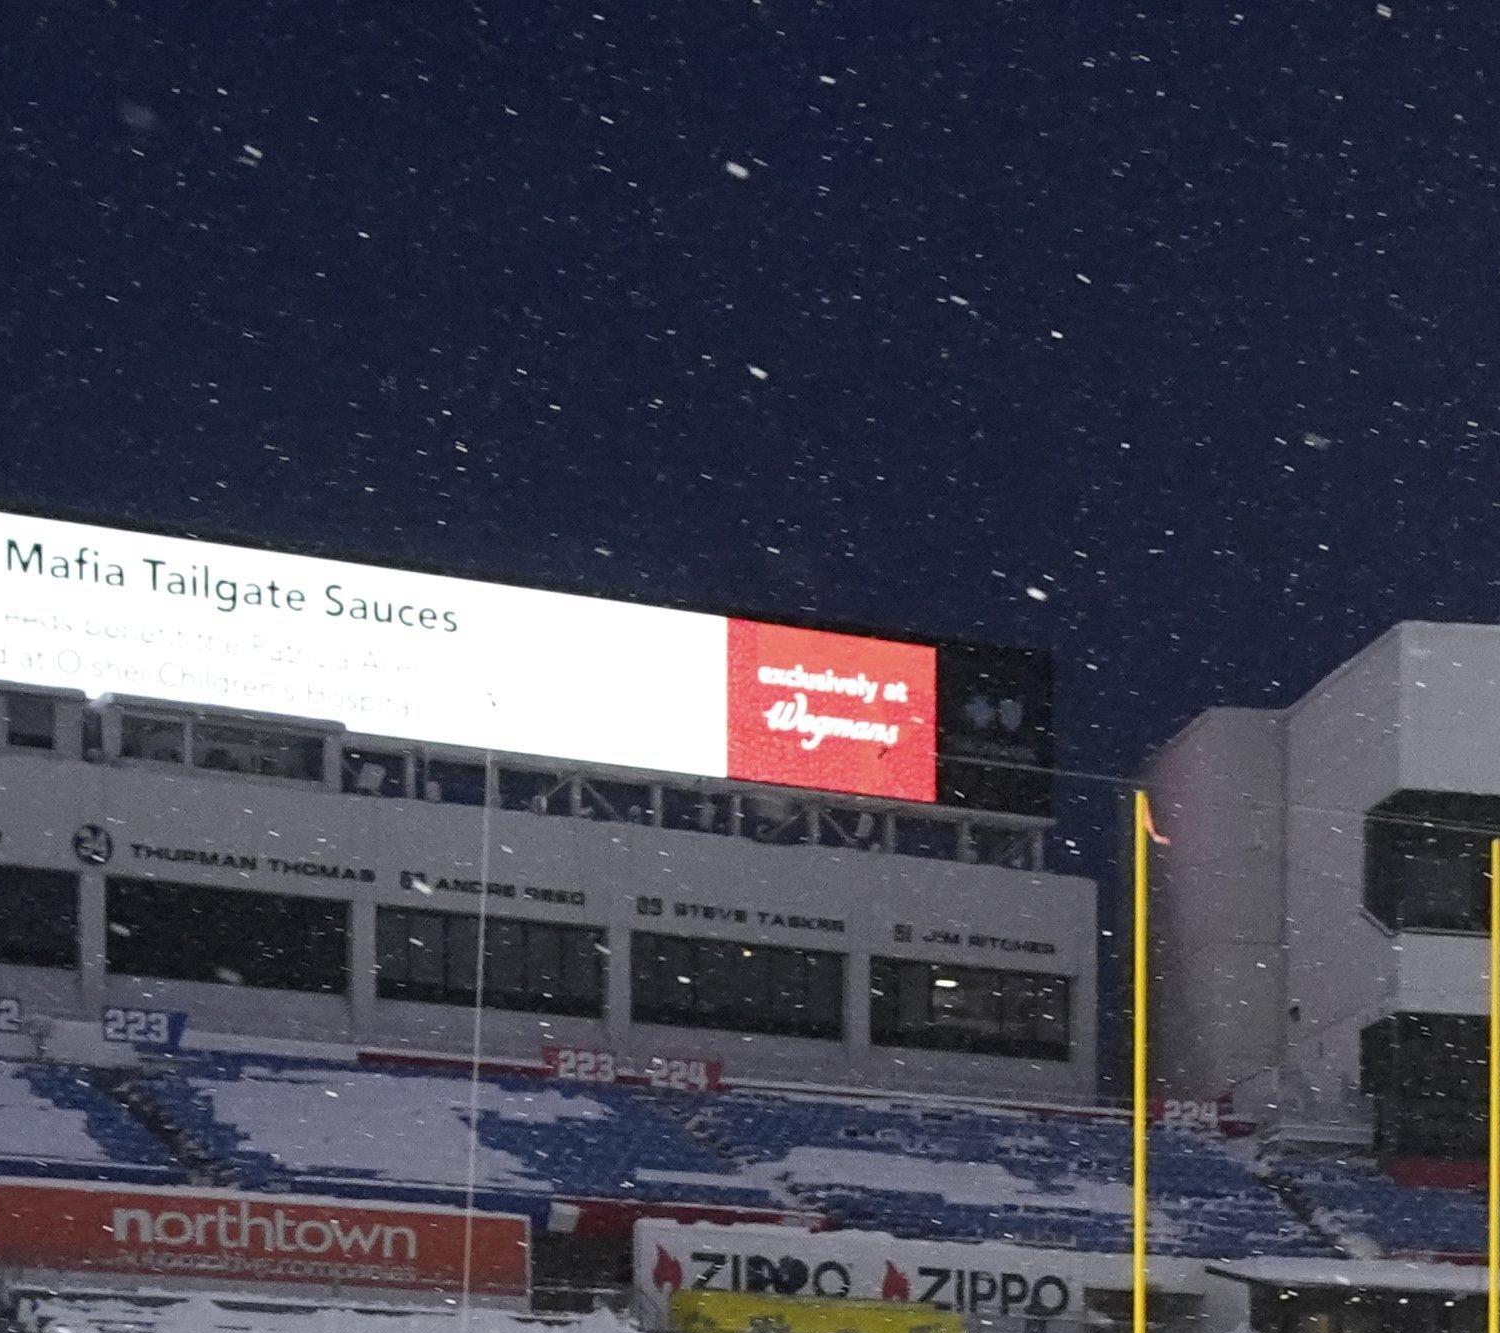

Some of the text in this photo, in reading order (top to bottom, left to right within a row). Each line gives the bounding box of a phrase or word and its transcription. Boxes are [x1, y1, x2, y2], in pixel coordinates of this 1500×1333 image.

[6, 539, 126, 588] Mafia
[143, 557, 306, 613] Tailgate
[324, 583, 459, 633] Sauces
[757, 663, 908, 707] exclusively at
[763, 697, 900, 751] Wegmans
[103, 1008, 169, 1043] 223
[557, 1048, 617, 1082] 223
[649, 1056, 707, 1091] 224
[1163, 1099, 1220, 1131] 224
[113, 1202, 417, 1259] northtown
[917, 1265, 1070, 1318] ZIPPO
